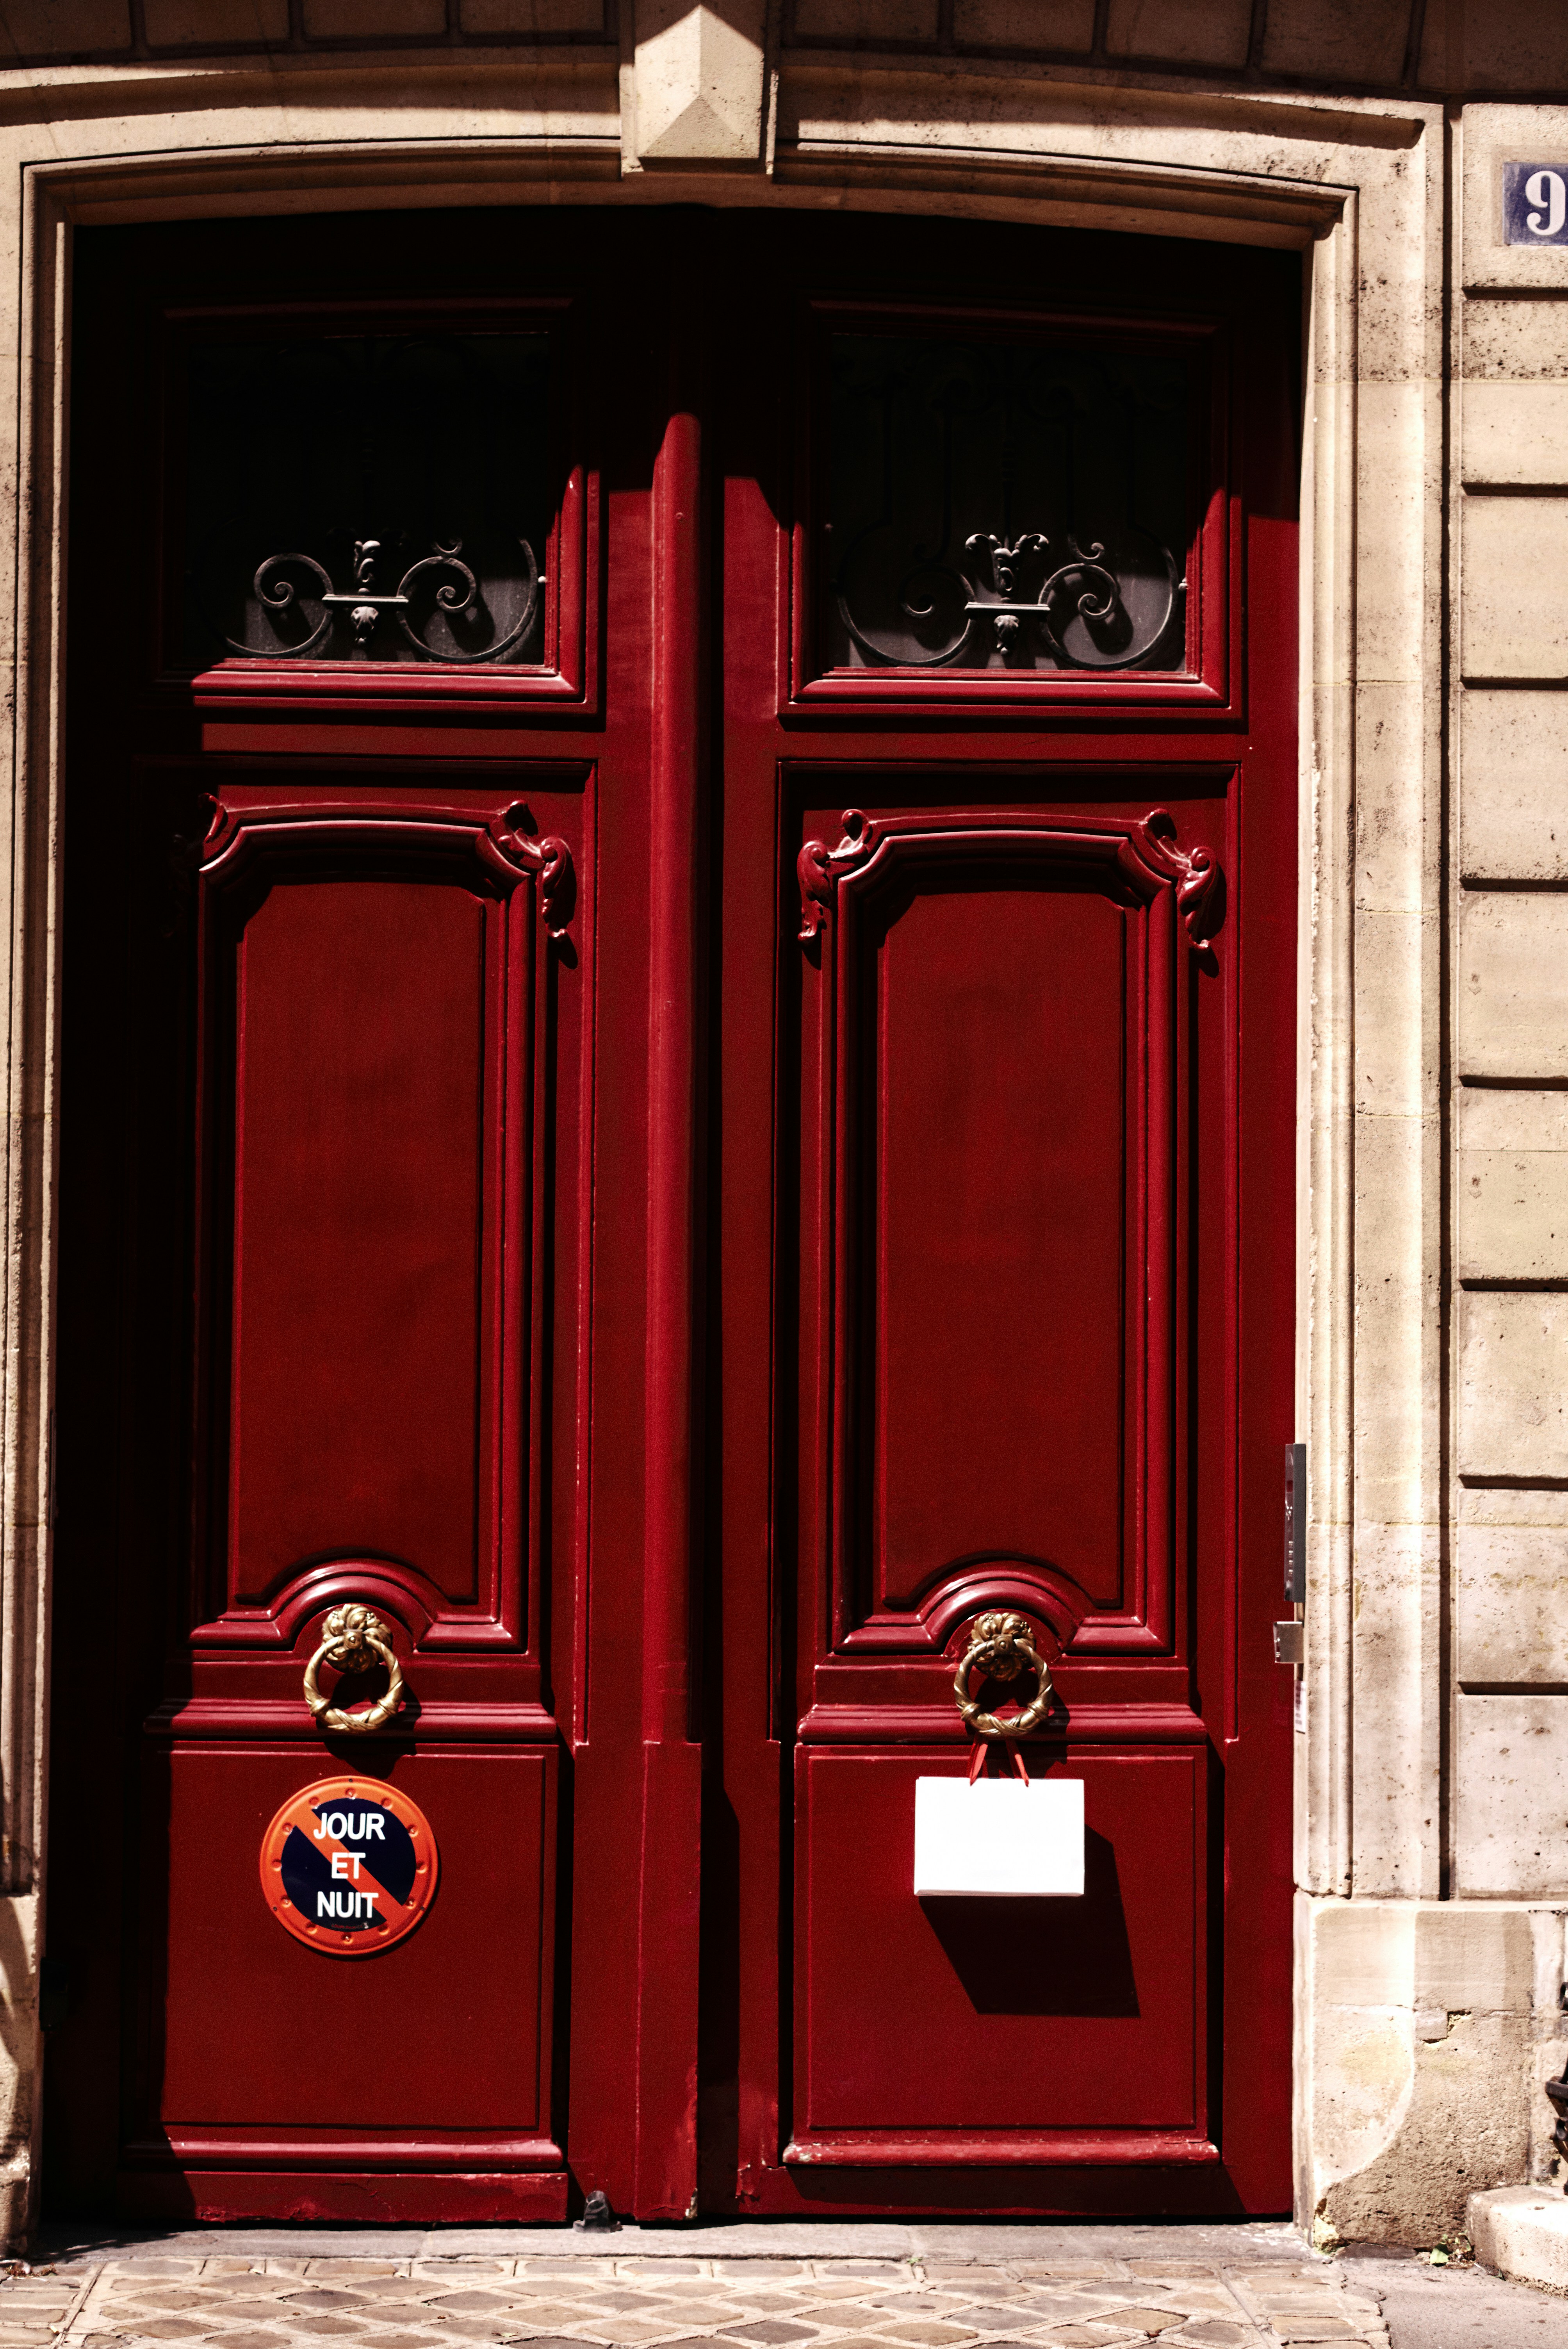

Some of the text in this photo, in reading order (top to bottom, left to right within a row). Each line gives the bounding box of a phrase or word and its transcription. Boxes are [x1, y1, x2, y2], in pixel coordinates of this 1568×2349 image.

[1525, 170, 1566, 235] 9
[313, 1812, 386, 1840] JOUR
[331, 1852, 366, 1879] ET
[317, 1891, 379, 1918] NUIT
